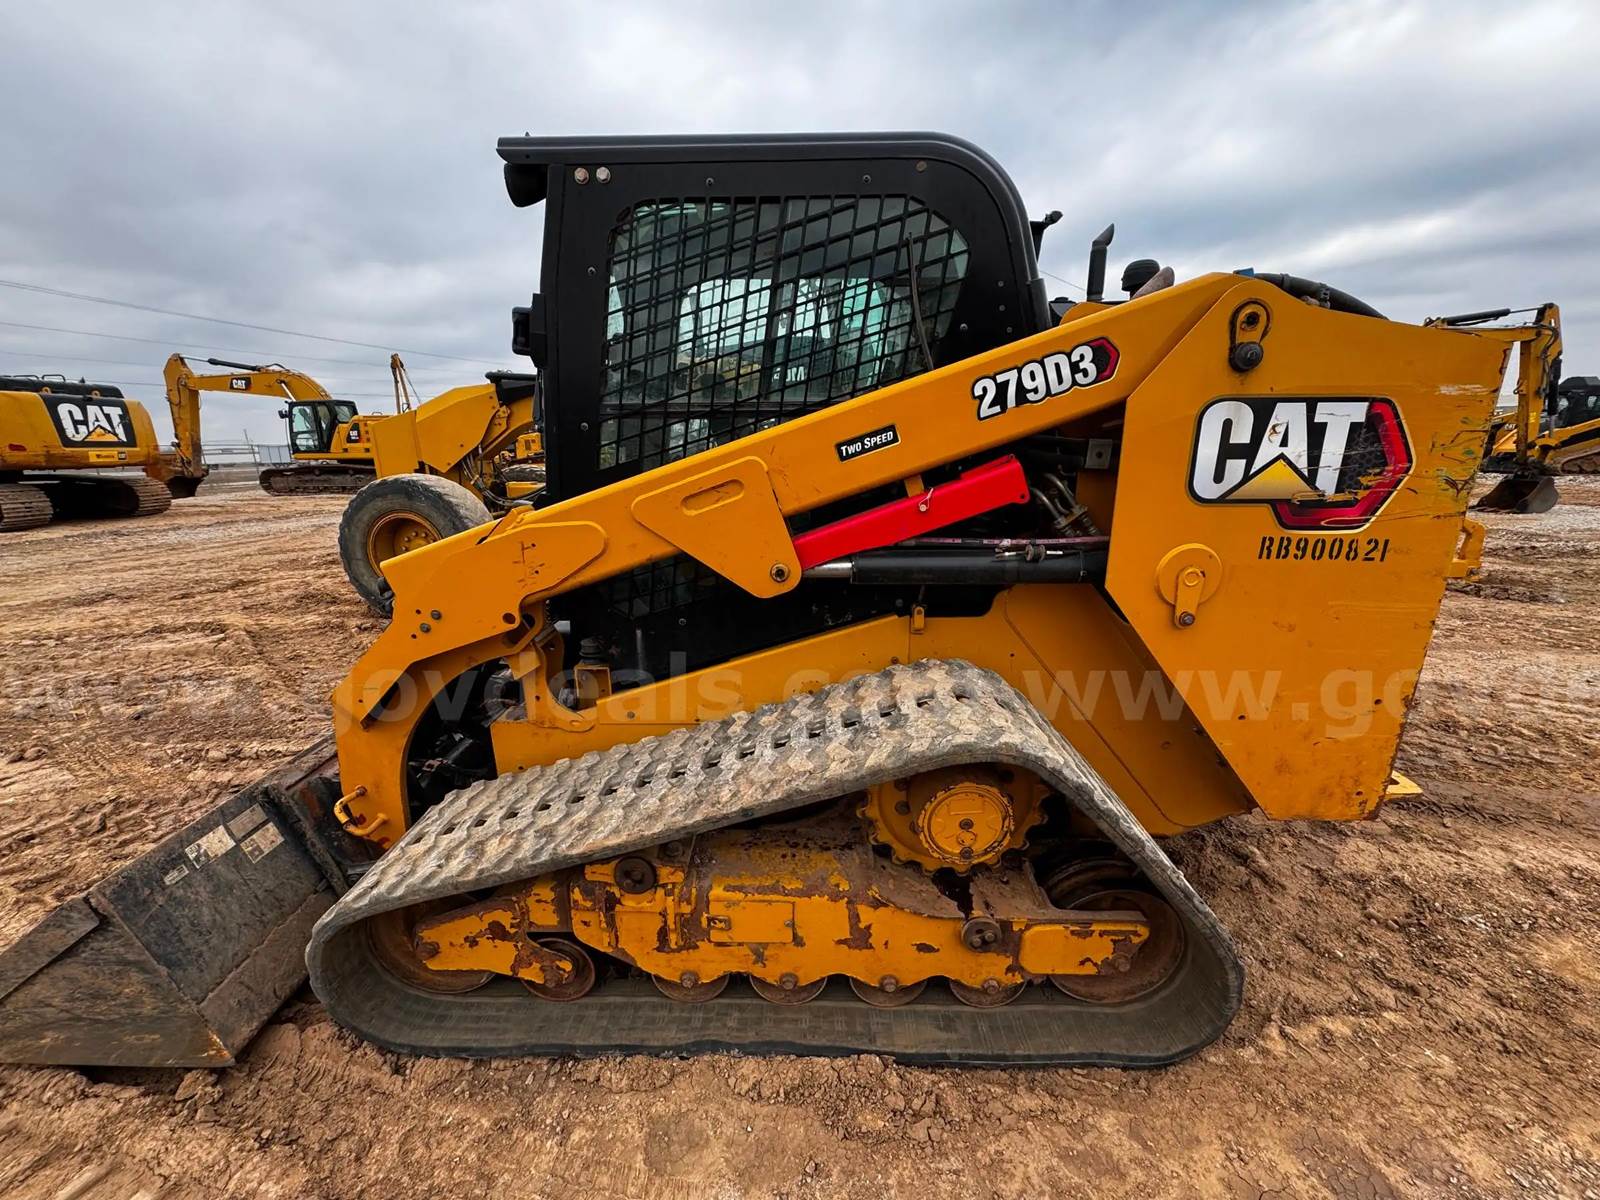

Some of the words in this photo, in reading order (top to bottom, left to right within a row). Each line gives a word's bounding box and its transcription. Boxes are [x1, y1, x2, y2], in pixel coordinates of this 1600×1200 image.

[232, 379, 246, 389] CAT
[973, 345, 1098, 418] 279D3
[57, 403, 127, 442] CAT
[840, 442, 862, 457] TWO
[863, 431, 894, 449] SPEED
[1193, 400, 1369, 499] CAT
[1258, 536, 1390, 562] RB900821
